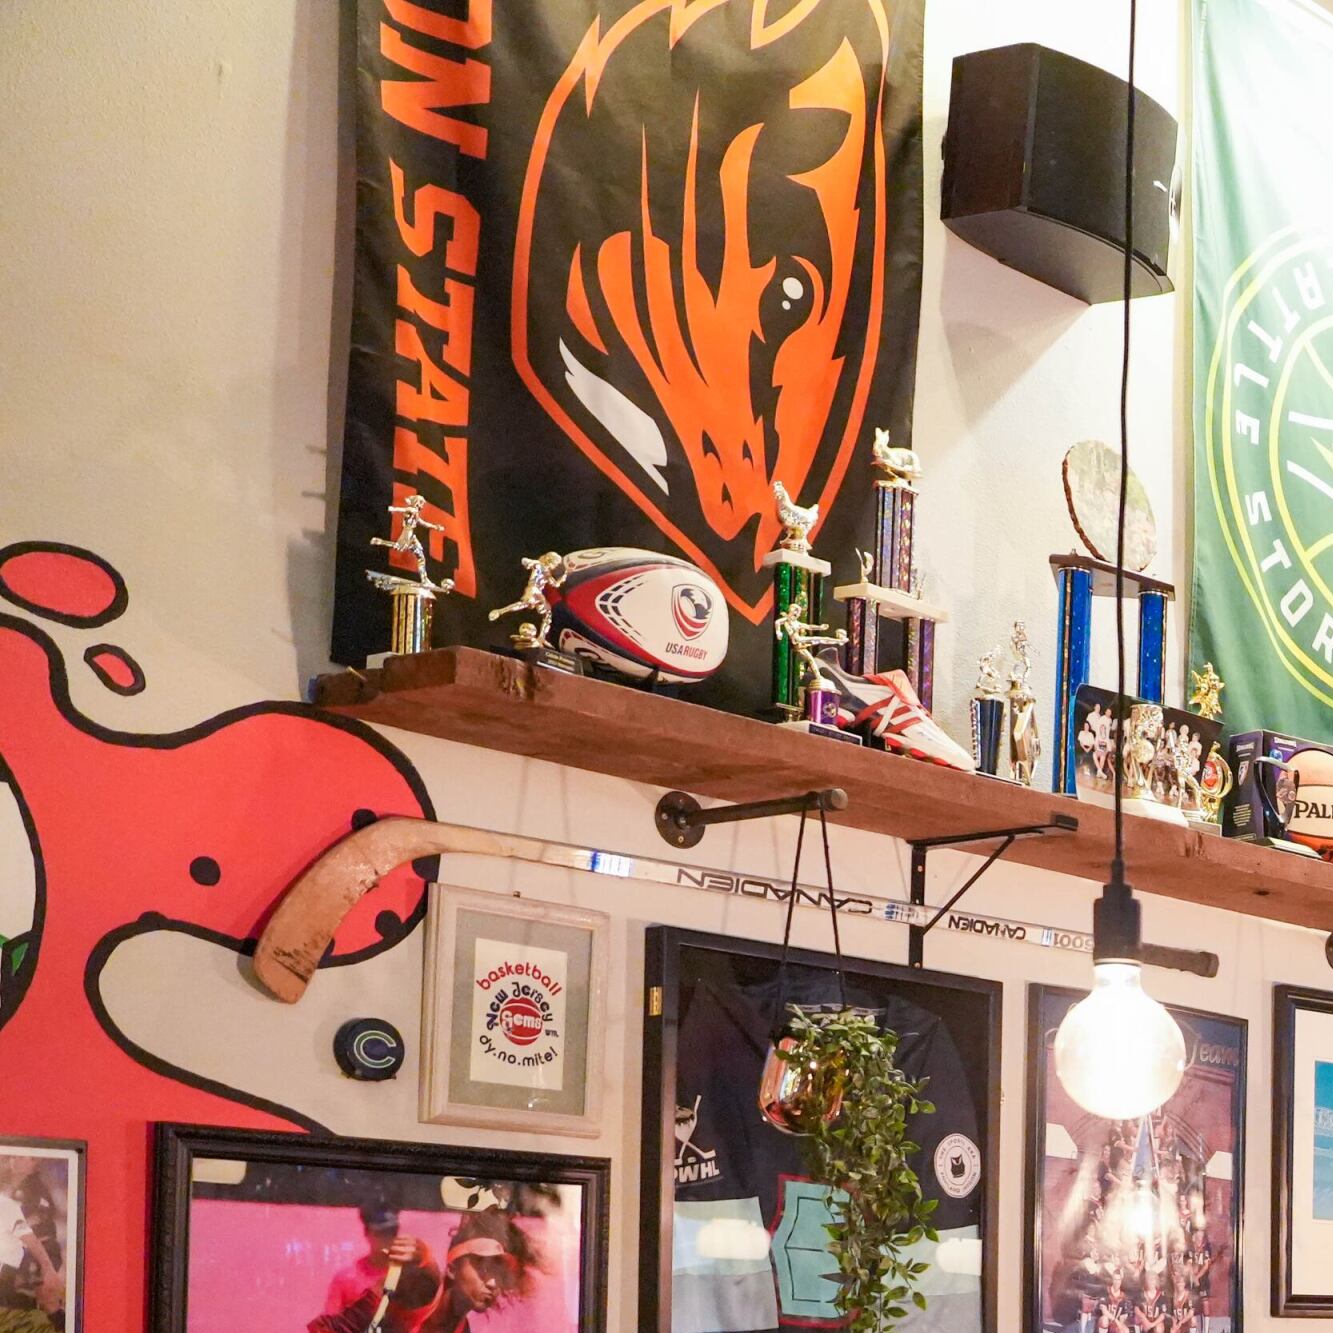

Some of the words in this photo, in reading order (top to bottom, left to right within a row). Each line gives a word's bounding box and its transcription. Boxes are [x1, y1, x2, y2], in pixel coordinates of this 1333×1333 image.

[389, 156, 481, 598] STATE
[676, 866, 874, 918] CANADIEN
[948, 914, 1027, 942] CANADIEN
[476, 961, 563, 997] basketball
[486, 988, 509, 1032] New
[511, 981, 554, 1023] Jersey
